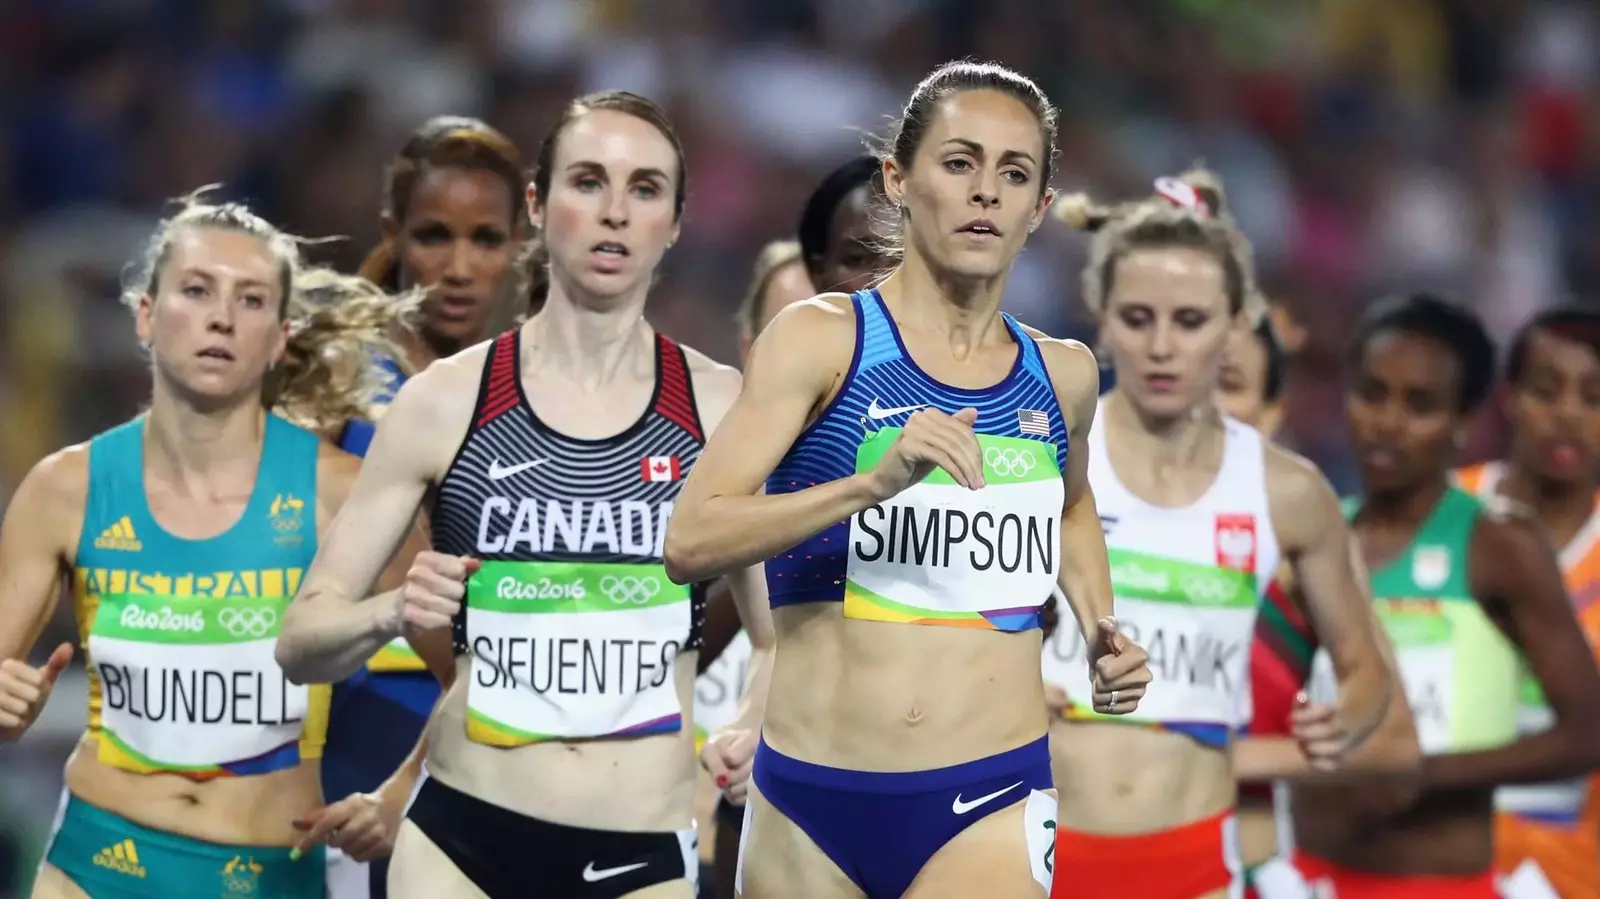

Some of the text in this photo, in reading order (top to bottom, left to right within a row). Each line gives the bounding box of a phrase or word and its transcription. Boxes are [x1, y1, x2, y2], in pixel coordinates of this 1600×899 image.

[854, 503, 1053, 575] SIMPSON
[85, 567, 309, 597] AUSTRALI
[100, 663, 302, 726] BLUNDELL
[473, 636, 680, 695] SIFUENTES
